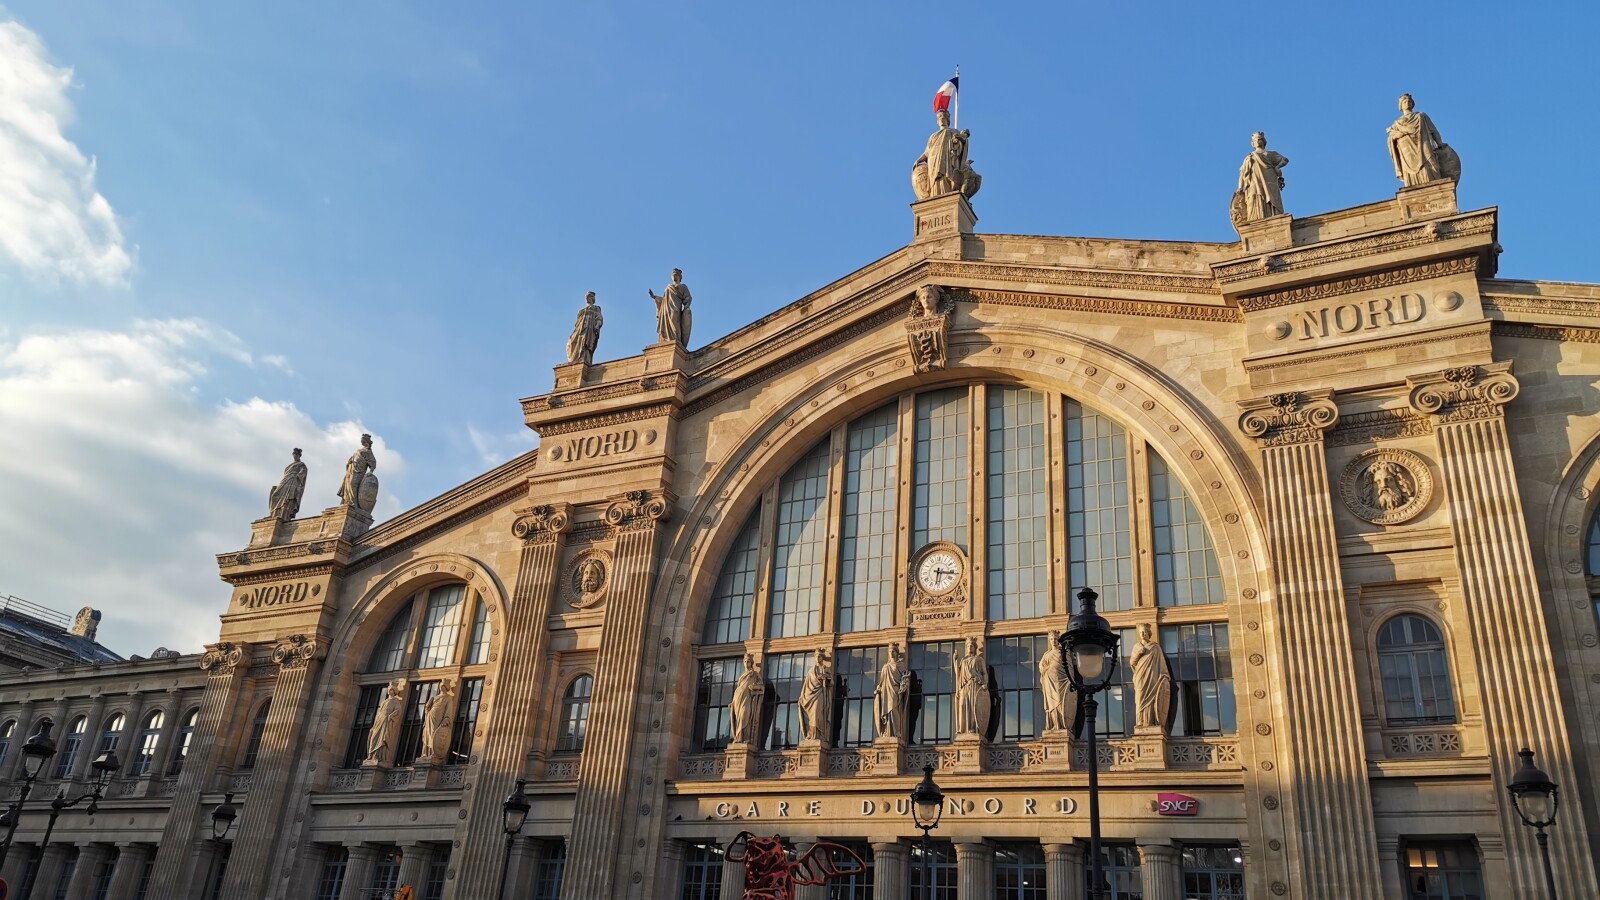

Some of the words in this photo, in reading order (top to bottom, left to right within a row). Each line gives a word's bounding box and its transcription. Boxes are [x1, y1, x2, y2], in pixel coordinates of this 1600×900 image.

[920, 215, 951, 231] PARIS
[1295, 292, 1427, 341] NORD
[563, 429, 639, 462] NORD
[246, 582, 309, 608] NORD
[715, 800, 820, 817] GARE
[861, 798, 909, 816] DU
[948, 797, 1076, 815] NORD
[1160, 800, 1196, 811] SNCF
